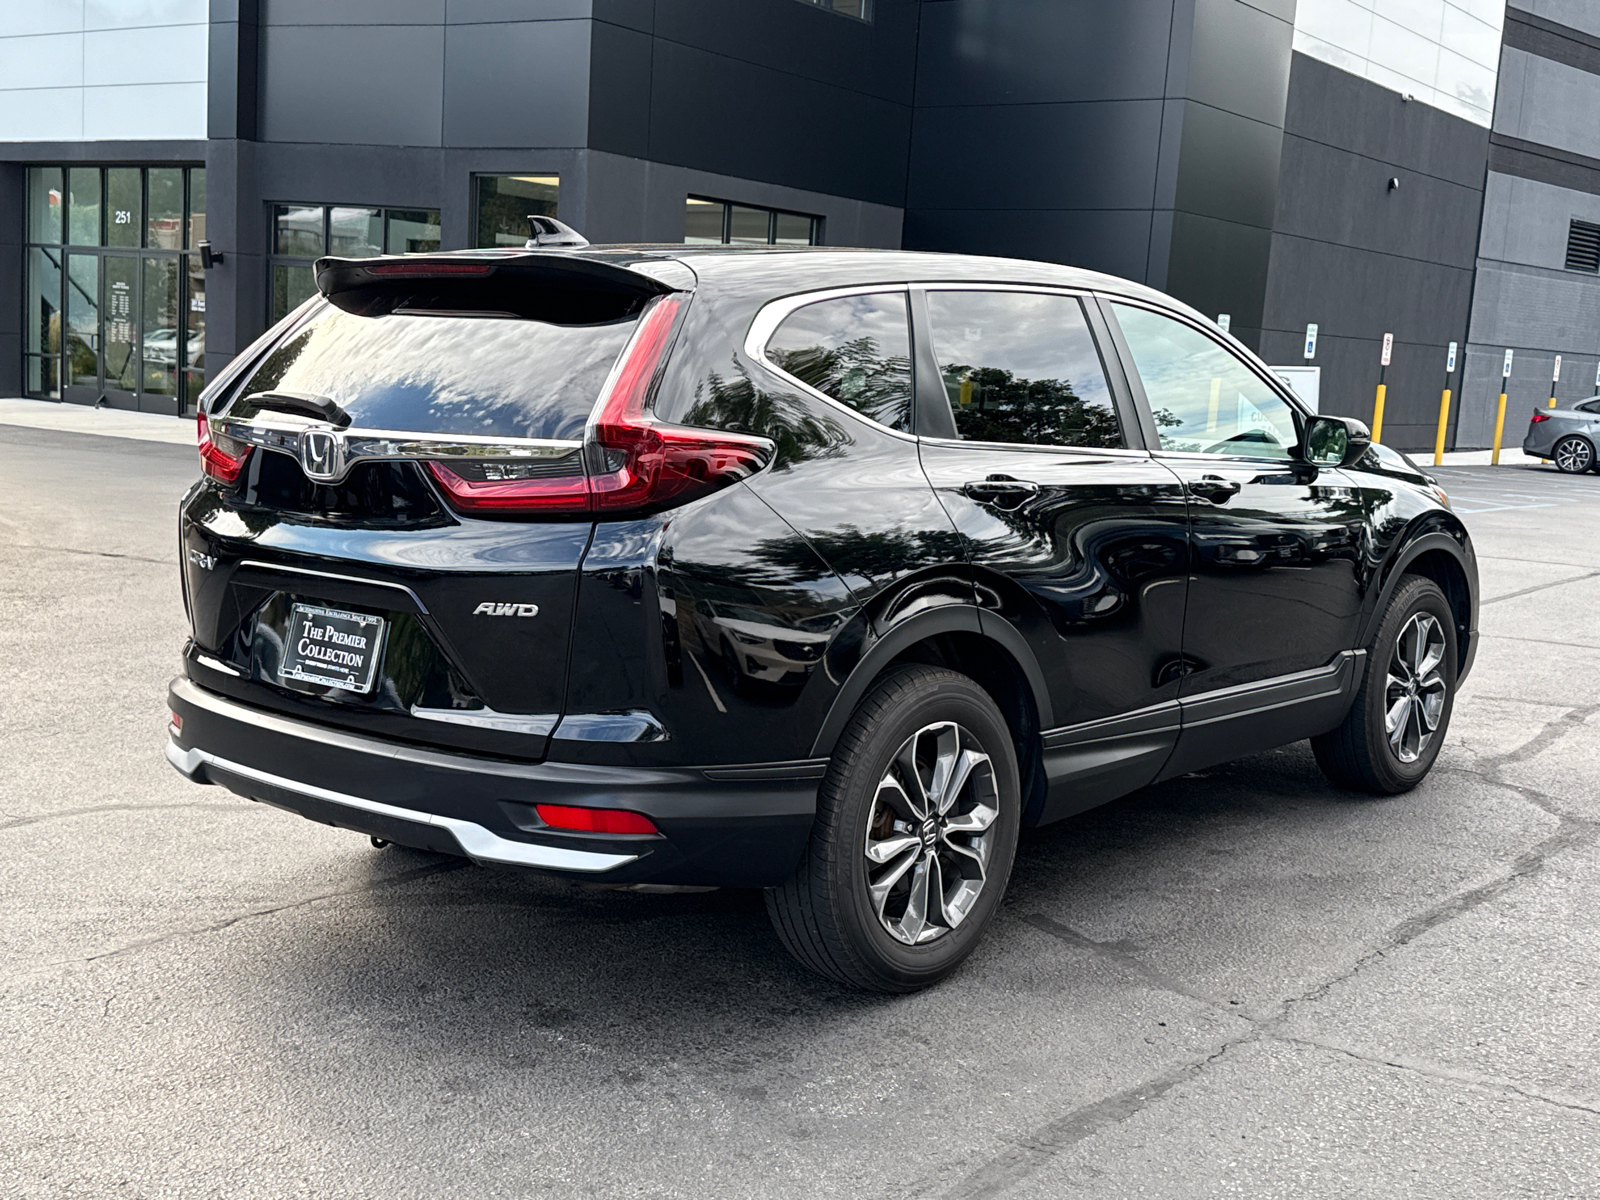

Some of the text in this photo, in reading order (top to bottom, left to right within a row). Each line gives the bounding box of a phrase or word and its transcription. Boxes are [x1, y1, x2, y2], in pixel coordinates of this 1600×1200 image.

[115, 210, 131, 224] 251
[472, 602, 539, 617] AWD
[302, 620, 367, 649] THE PREMIER
[297, 638, 364, 667] COLLECTION
